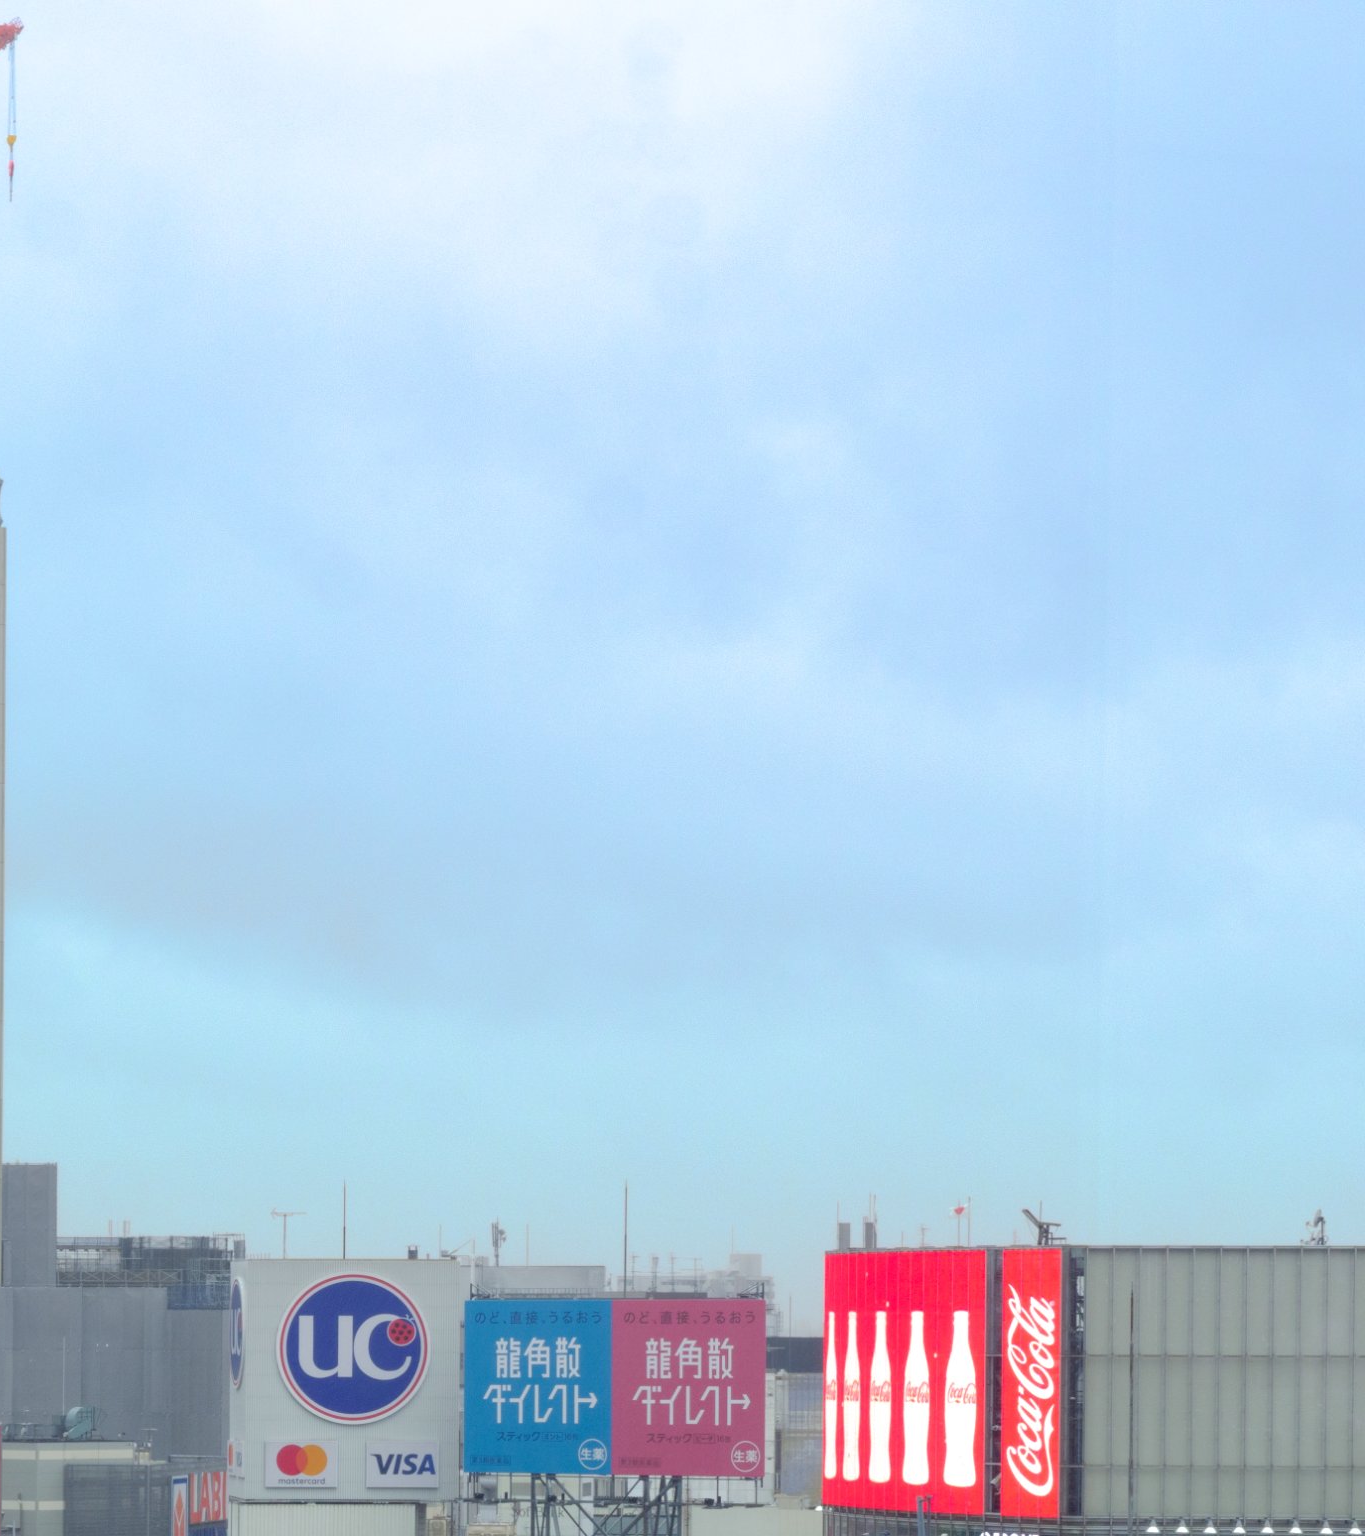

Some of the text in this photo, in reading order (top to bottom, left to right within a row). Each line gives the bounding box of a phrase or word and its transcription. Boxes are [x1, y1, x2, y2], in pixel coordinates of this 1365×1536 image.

[474, 1311, 604, 1325] のど、直接、うるおう
[623, 1311, 756, 1325] のど、直接、うるおう
[495, 1337, 581, 1379] 龍角散
[645, 1337, 734, 1380] 龍角散
[1006, 1284, 1055, 1496] Coca-Cola
[484, 1384, 598, 1424] ダイレクト
[633, 1385, 751, 1426] ダイレクト
[370, 1453, 436, 1476] VISA
[580, 1448, 605, 1462] 生薬
[733, 1450, 758, 1463] 生薬
[278, 1477, 326, 1486] mastercard
